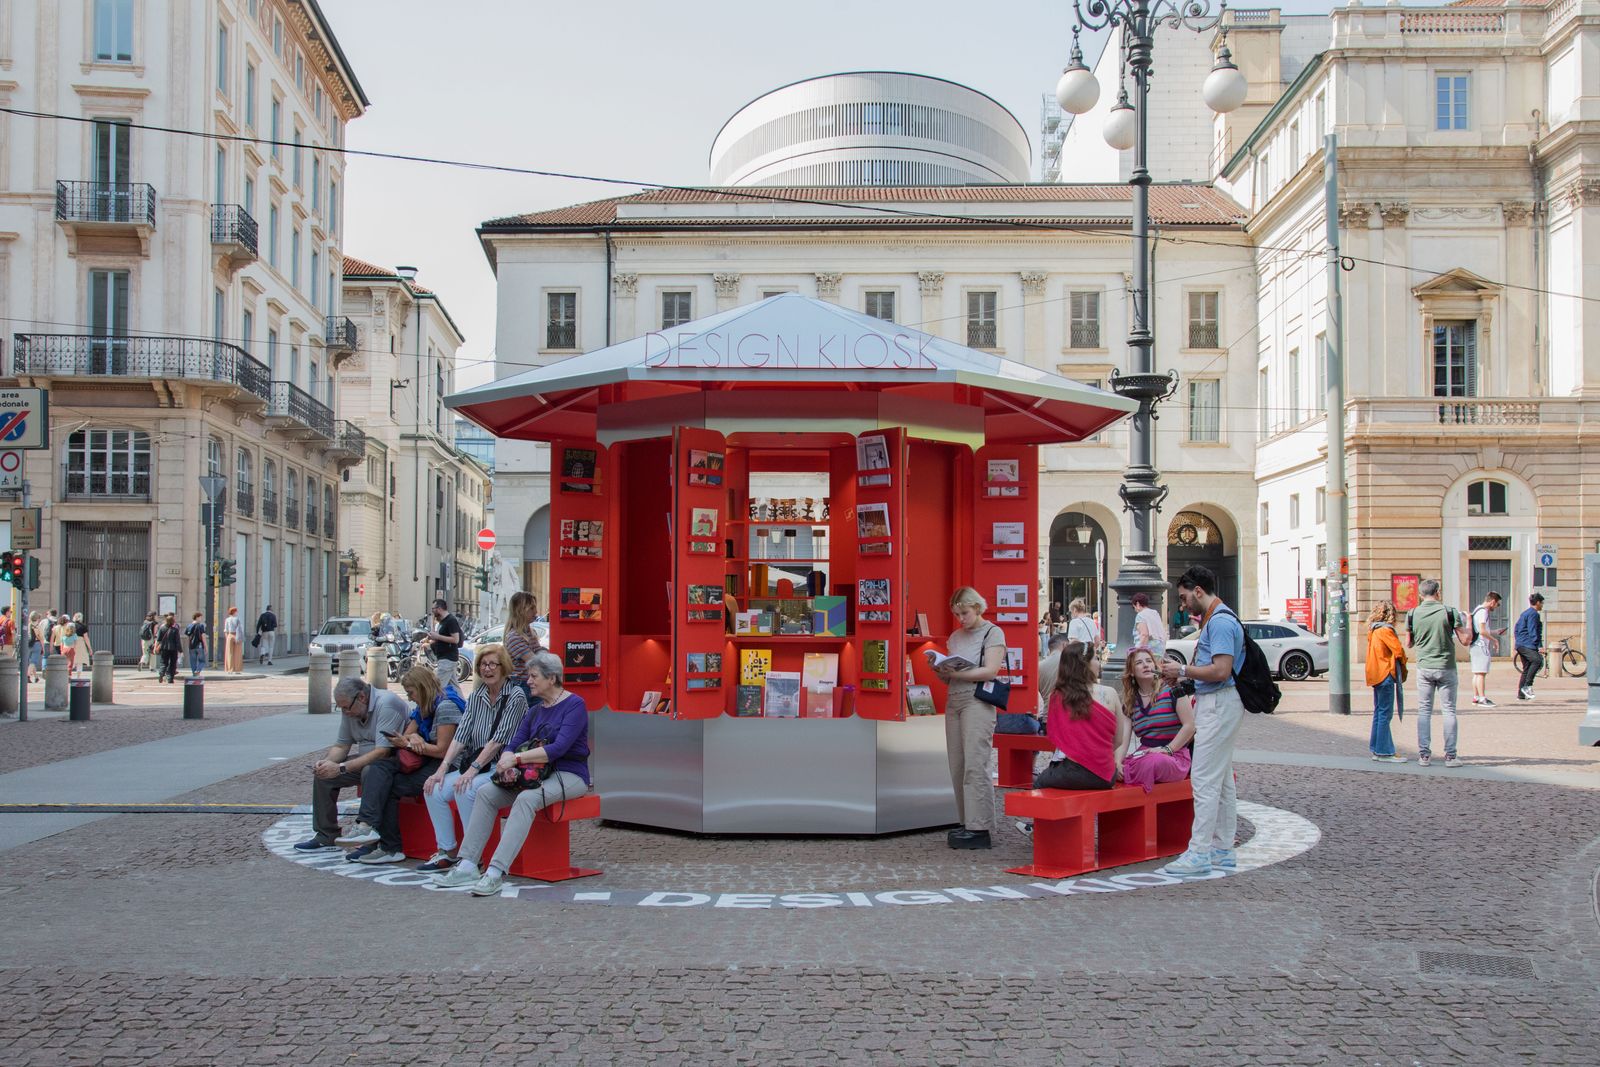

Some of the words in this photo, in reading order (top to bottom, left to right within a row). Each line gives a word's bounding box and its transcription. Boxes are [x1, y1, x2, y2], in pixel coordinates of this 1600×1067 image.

[644, 332, 799, 369] DESIGN
[818, 333, 938, 370] KIOSK
[877, 642, 885, 690] LINSED
[637, 885, 1031, 910] DESIGN
